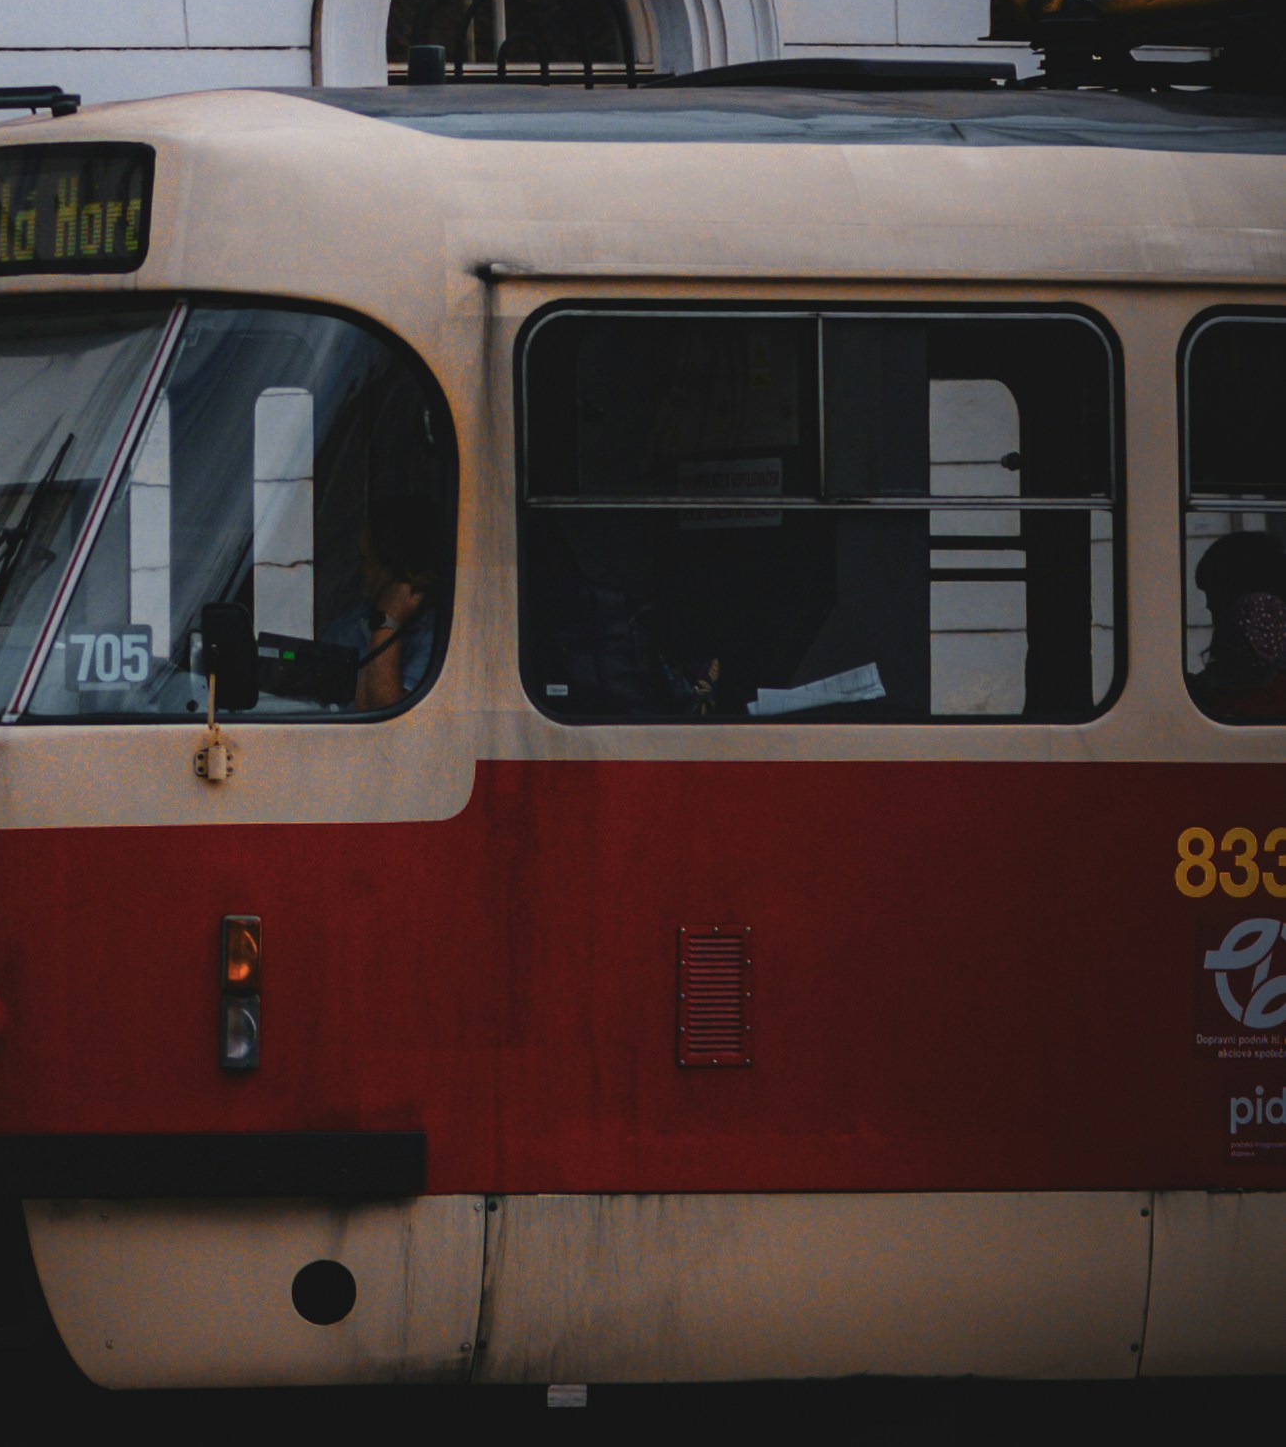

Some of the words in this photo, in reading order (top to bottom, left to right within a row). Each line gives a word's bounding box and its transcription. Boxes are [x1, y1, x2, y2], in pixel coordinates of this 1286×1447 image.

[69, 633, 149, 682] 705
[1238, 1034, 1268, 1047] podnik
[1230, 1084, 1286, 1134] pid
